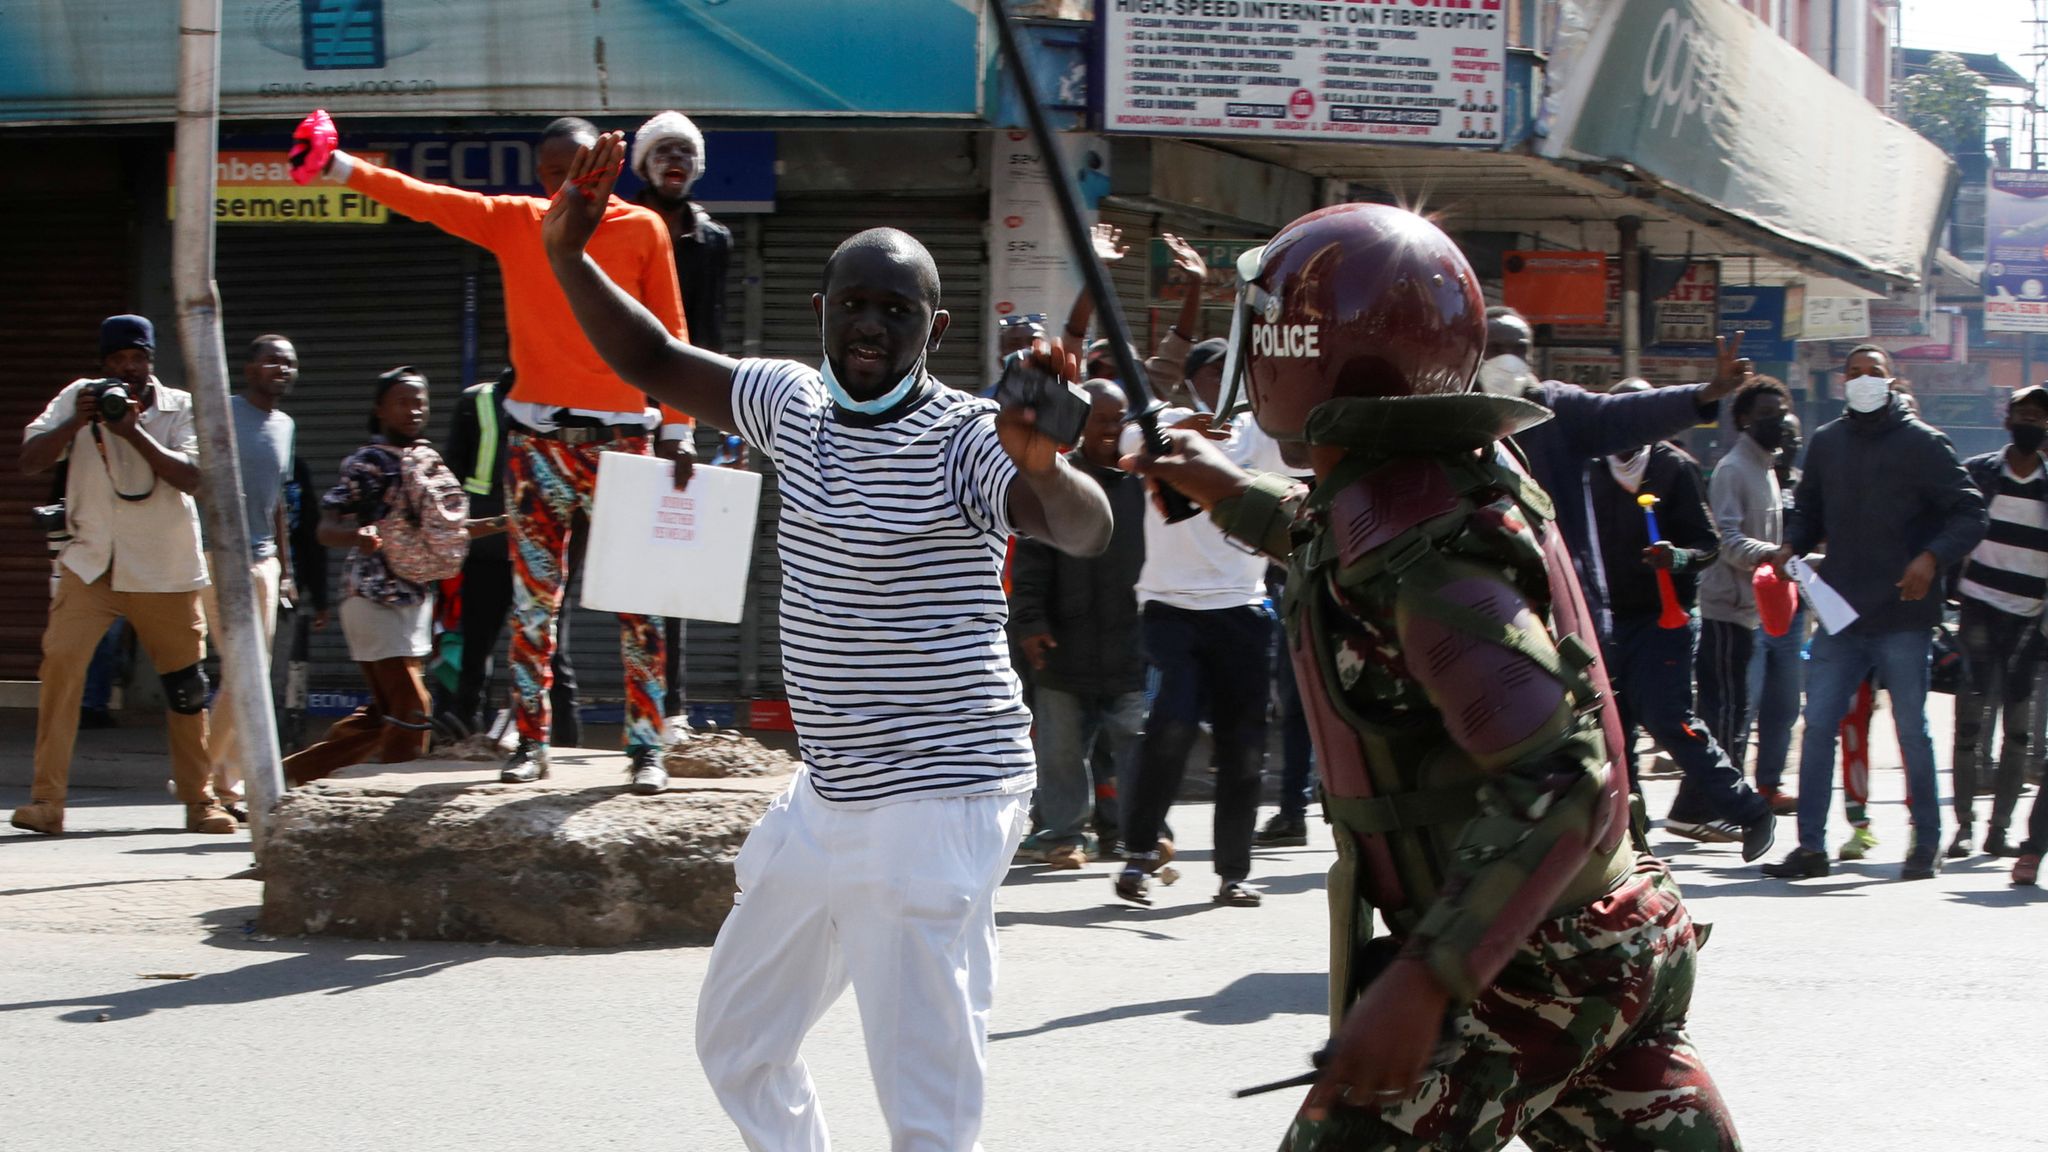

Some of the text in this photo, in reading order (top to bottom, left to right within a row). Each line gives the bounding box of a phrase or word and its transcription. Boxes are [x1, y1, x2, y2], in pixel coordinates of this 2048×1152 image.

[1116, 0, 1240, 18] HIGH-SPEED
[1244, 2, 1339, 22] INTERNET
[1346, 7, 1374, 24] ON
[1381, 9, 1437, 27] FIBRE
[1441, 12, 1496, 30] OPTIC
[1228, 105, 1254, 115] OPEN
[368, 140, 545, 186] TECN
[1252, 324, 1320, 358] POLICE
